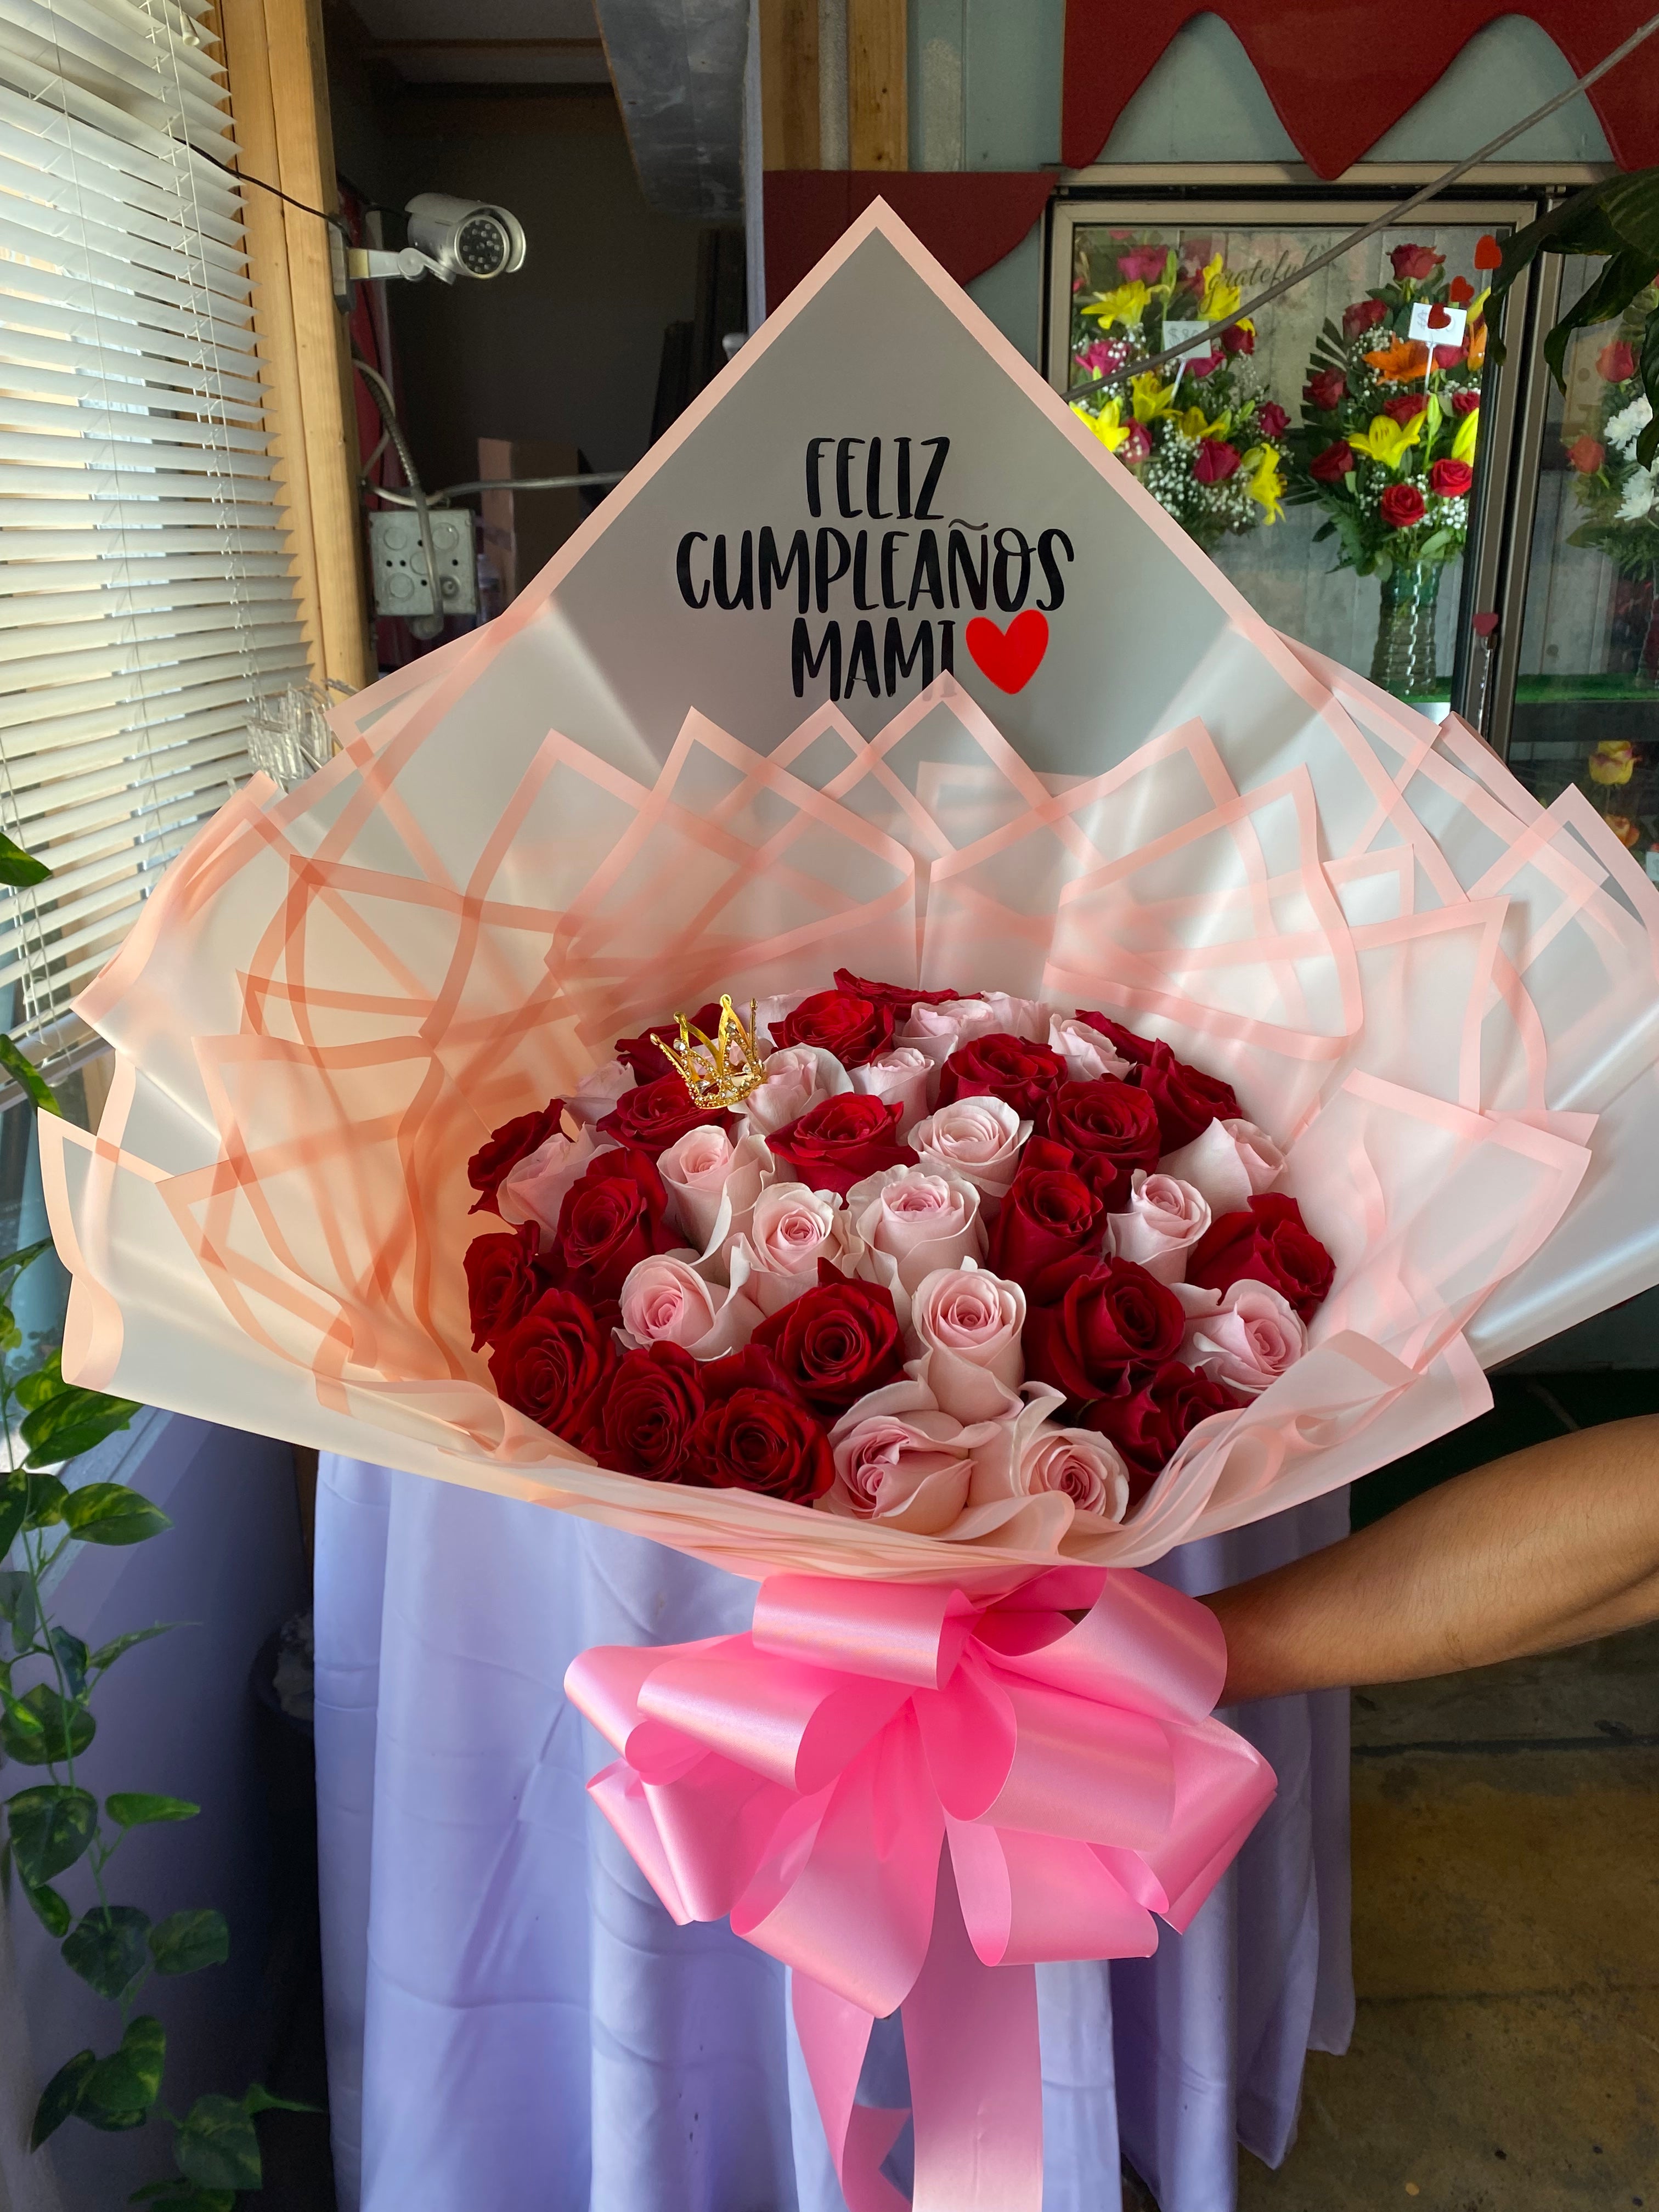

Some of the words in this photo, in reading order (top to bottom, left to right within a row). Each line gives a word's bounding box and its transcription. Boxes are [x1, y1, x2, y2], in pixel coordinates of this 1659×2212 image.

[805, 436, 951, 520] FELIZ
[676, 518, 1075, 614] CUMPLEAÑOS
[791, 617, 958, 702] MAMI
